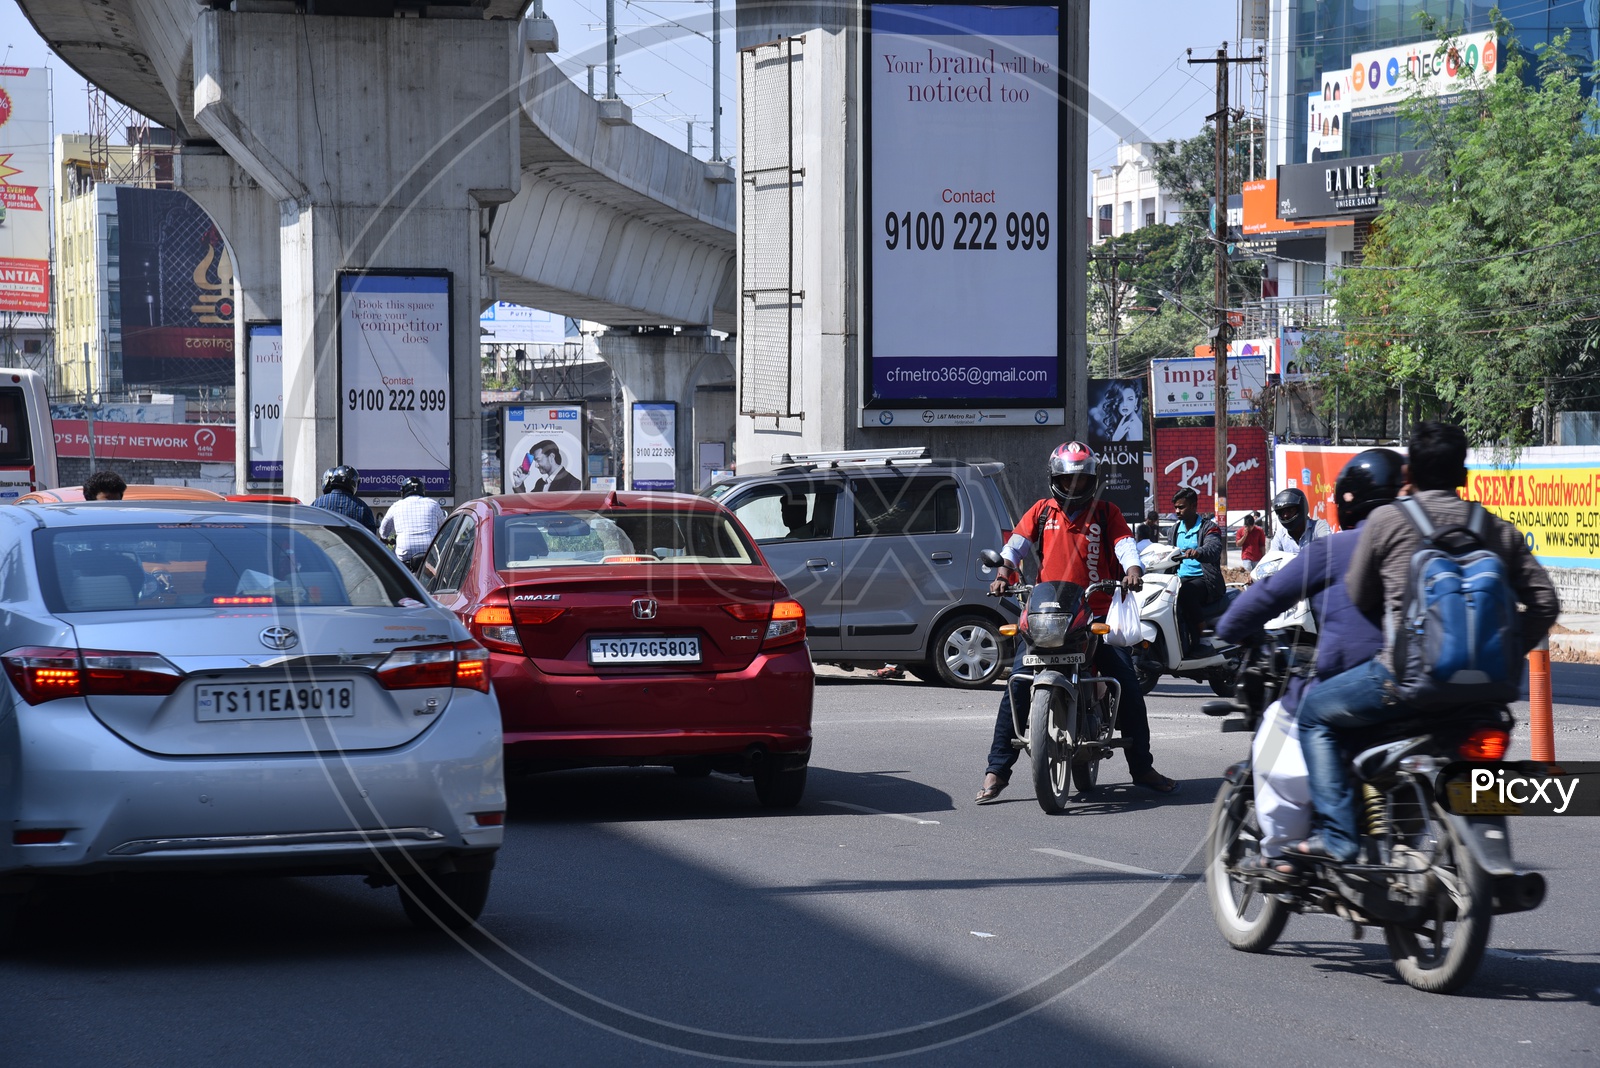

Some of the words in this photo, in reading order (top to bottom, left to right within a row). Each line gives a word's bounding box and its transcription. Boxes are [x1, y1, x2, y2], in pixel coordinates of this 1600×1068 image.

[883, 54, 923, 74] Your
[928, 49, 996, 74] brand
[1000, 57, 1027, 73] will
[1032, 57, 1050, 74] be
[907, 77, 993, 103] noticed
[1001, 84, 1029, 103] too
[1326, 164, 1375, 192] BANGS
[942, 188, 996, 203] Contact
[1335, 199, 1356, 208] UNISEX
[1357, 197, 1376, 206] SALON
[885, 211, 945, 250] 9100
[953, 211, 998, 250] 222
[1006, 211, 1050, 250] 999
[358, 299, 383, 309] Book
[386, 299, 405, 309] this
[407, 302, 435, 311] space
[351, 310, 382, 320] before
[384, 313, 407, 322] your
[361, 318, 443, 335] competitor
[185, 335, 234, 352] coming
[402, 333, 429, 344] does
[382, 376, 414, 386] Contact
[886, 366, 1048, 385] cfmetro365@gmail.com
[1164, 364, 1239, 388] impat
[348, 389, 384, 411] 9100
[389, 389, 415, 411] 222
[420, 389, 446, 412] 999
[254, 404, 280, 419] 9100
[129, 436, 188, 448] NETWORK
[636, 447, 650, 457] 9100
[652, 447, 662, 457] 222
[664, 447, 675, 457] 999
[1094, 452, 1139, 465] SALON
[1474, 474, 1527, 507] SEEMA
[1529, 474, 1592, 507] Sandalwood
[1509, 511, 1569, 527] SANDALWOOD
[1576, 511, 1600, 528] PLOT
[1086, 523, 1102, 585] omato
[600, 641, 697, 658] TS07GG5803
[1050, 656, 1060, 664] AQ
[212, 687, 350, 713] TS11EA9018
